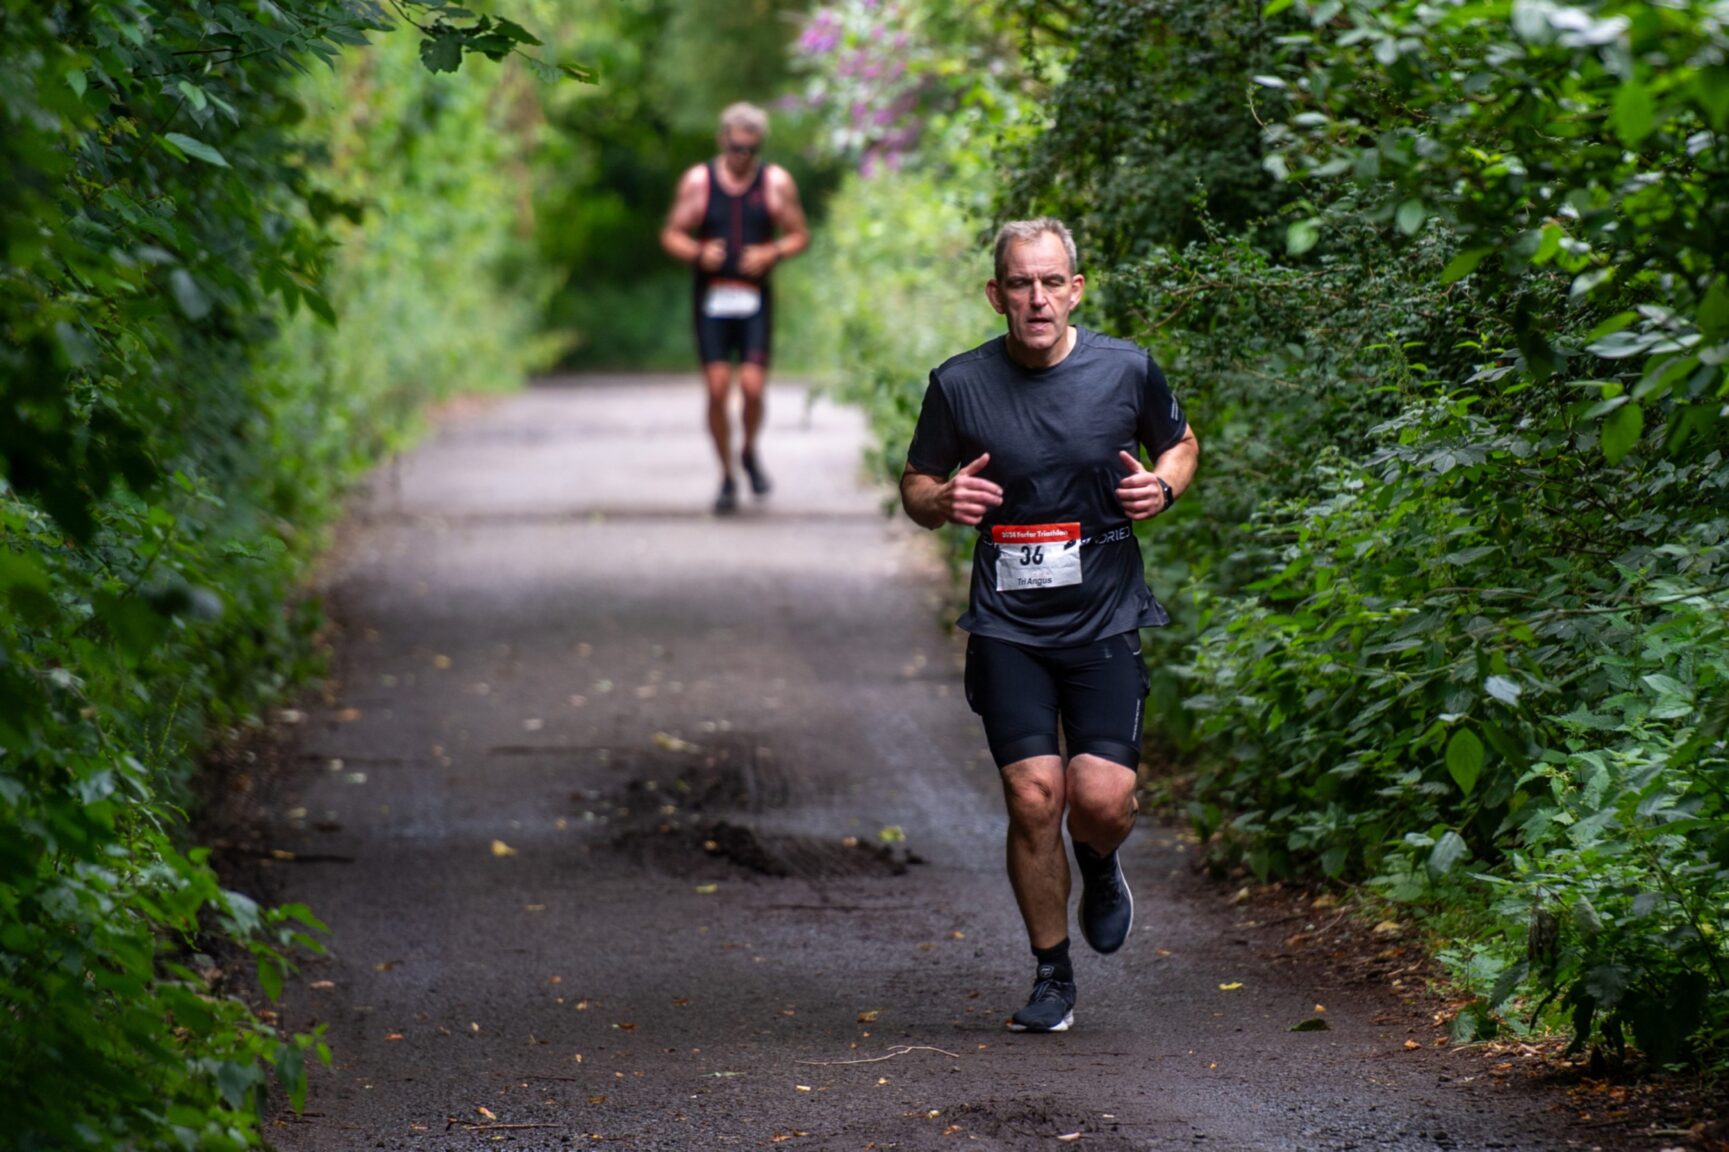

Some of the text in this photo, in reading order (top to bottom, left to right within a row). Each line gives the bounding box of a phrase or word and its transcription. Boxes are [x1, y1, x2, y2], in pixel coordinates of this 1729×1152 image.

[1037, 529, 1069, 537] Triathlon
[1020, 545, 1044, 566] 36
[1027, 577, 1053, 586] Angus
